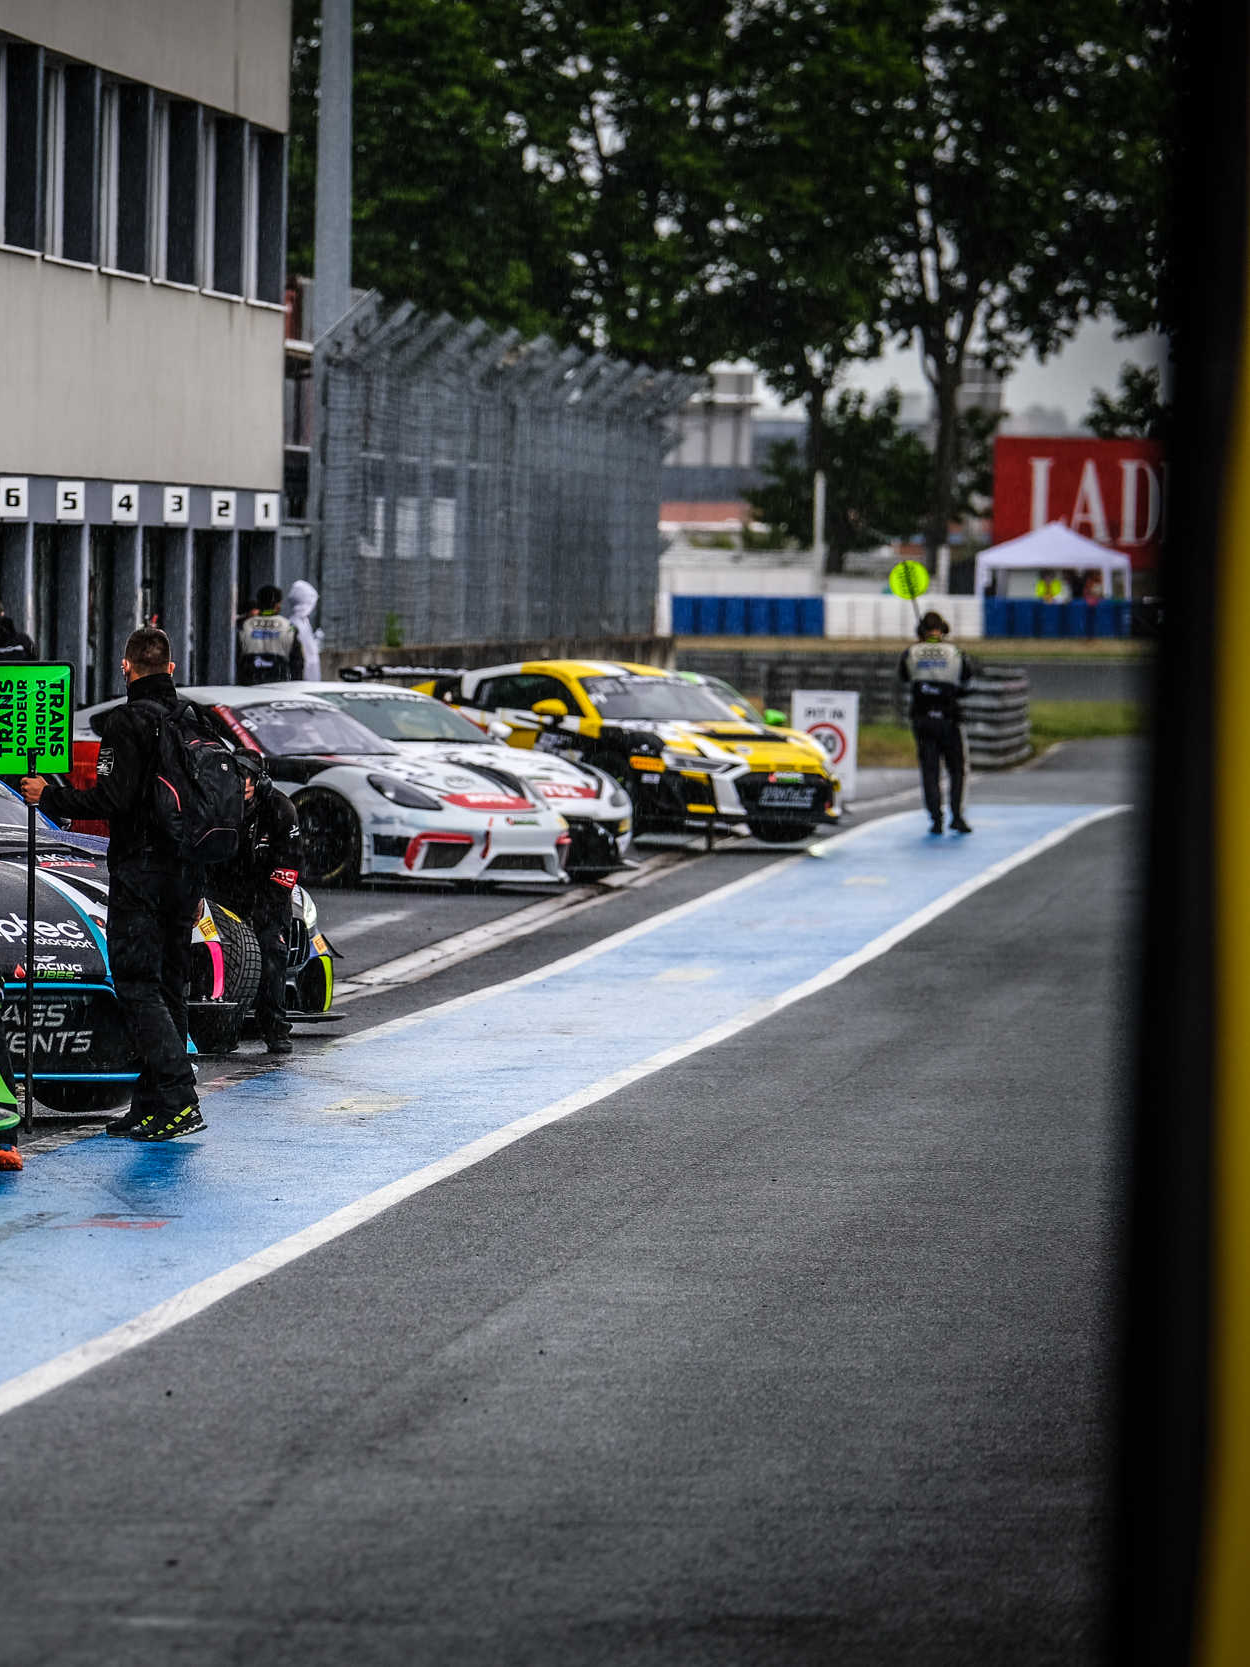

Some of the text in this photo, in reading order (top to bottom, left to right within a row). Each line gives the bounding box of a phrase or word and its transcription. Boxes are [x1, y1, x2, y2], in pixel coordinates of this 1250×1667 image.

[5, 488, 21, 507] 6
[63, 491, 77, 510] 5
[118, 495, 133, 512] 4
[171, 496, 184, 513] 3
[1028, 456, 1170, 546] LAD
[217, 500, 230, 517] 2
[262, 503, 269, 518] 1
[16, 679, 28, 756] PONDEUR
[35, 679, 47, 757] PONDEUR
[50, 678, 65, 757] TRANS
[5, 1029, 94, 1055] ENTS
